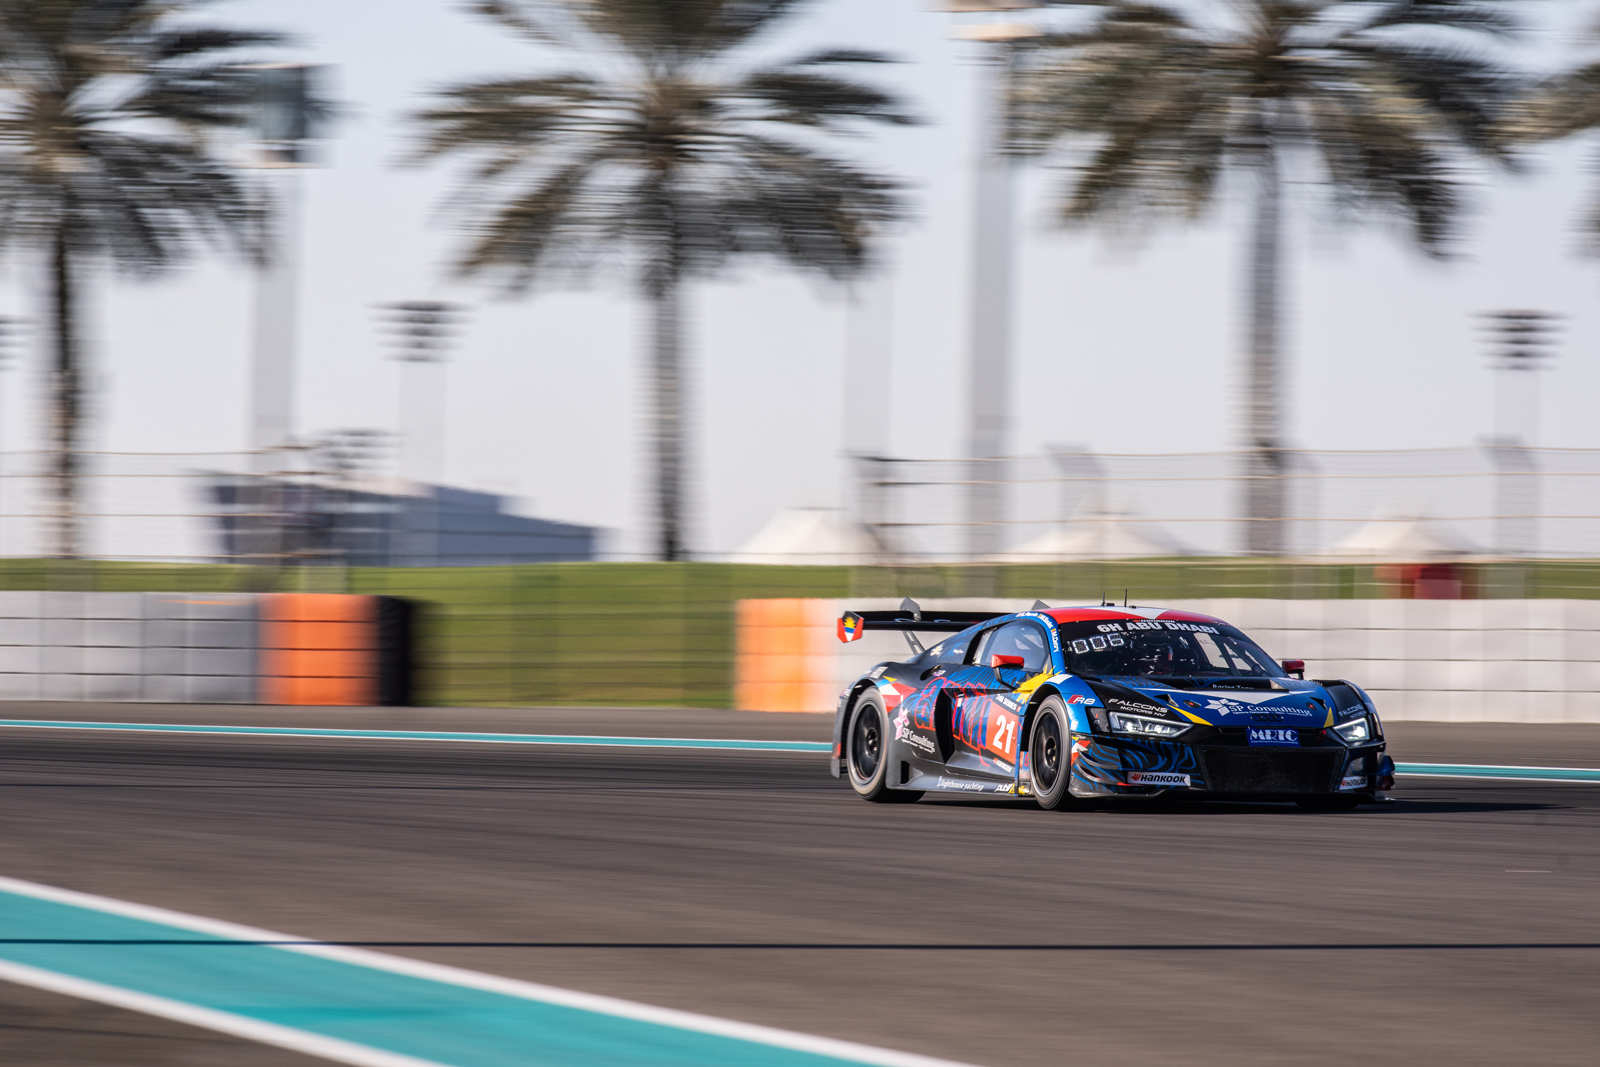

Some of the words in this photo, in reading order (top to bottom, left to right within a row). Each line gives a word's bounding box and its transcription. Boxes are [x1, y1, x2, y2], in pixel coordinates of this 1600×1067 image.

[1096, 622, 1124, 632] 6H
[1126, 622, 1162, 631] ABU
[1164, 622, 1220, 635] DHABI
[1072, 696, 1096, 705] R8
[1108, 698, 1169, 713] FALCONS
[1120, 706, 1153, 715] MOTORS
[1247, 705, 1312, 717] Consulting
[1338, 704, 1364, 717] FALCONS
[902, 727, 910, 738] SP
[993, 714, 1016, 755] 21
[1250, 729, 1298, 742] MRTC
[963, 782, 985, 791] yachting
